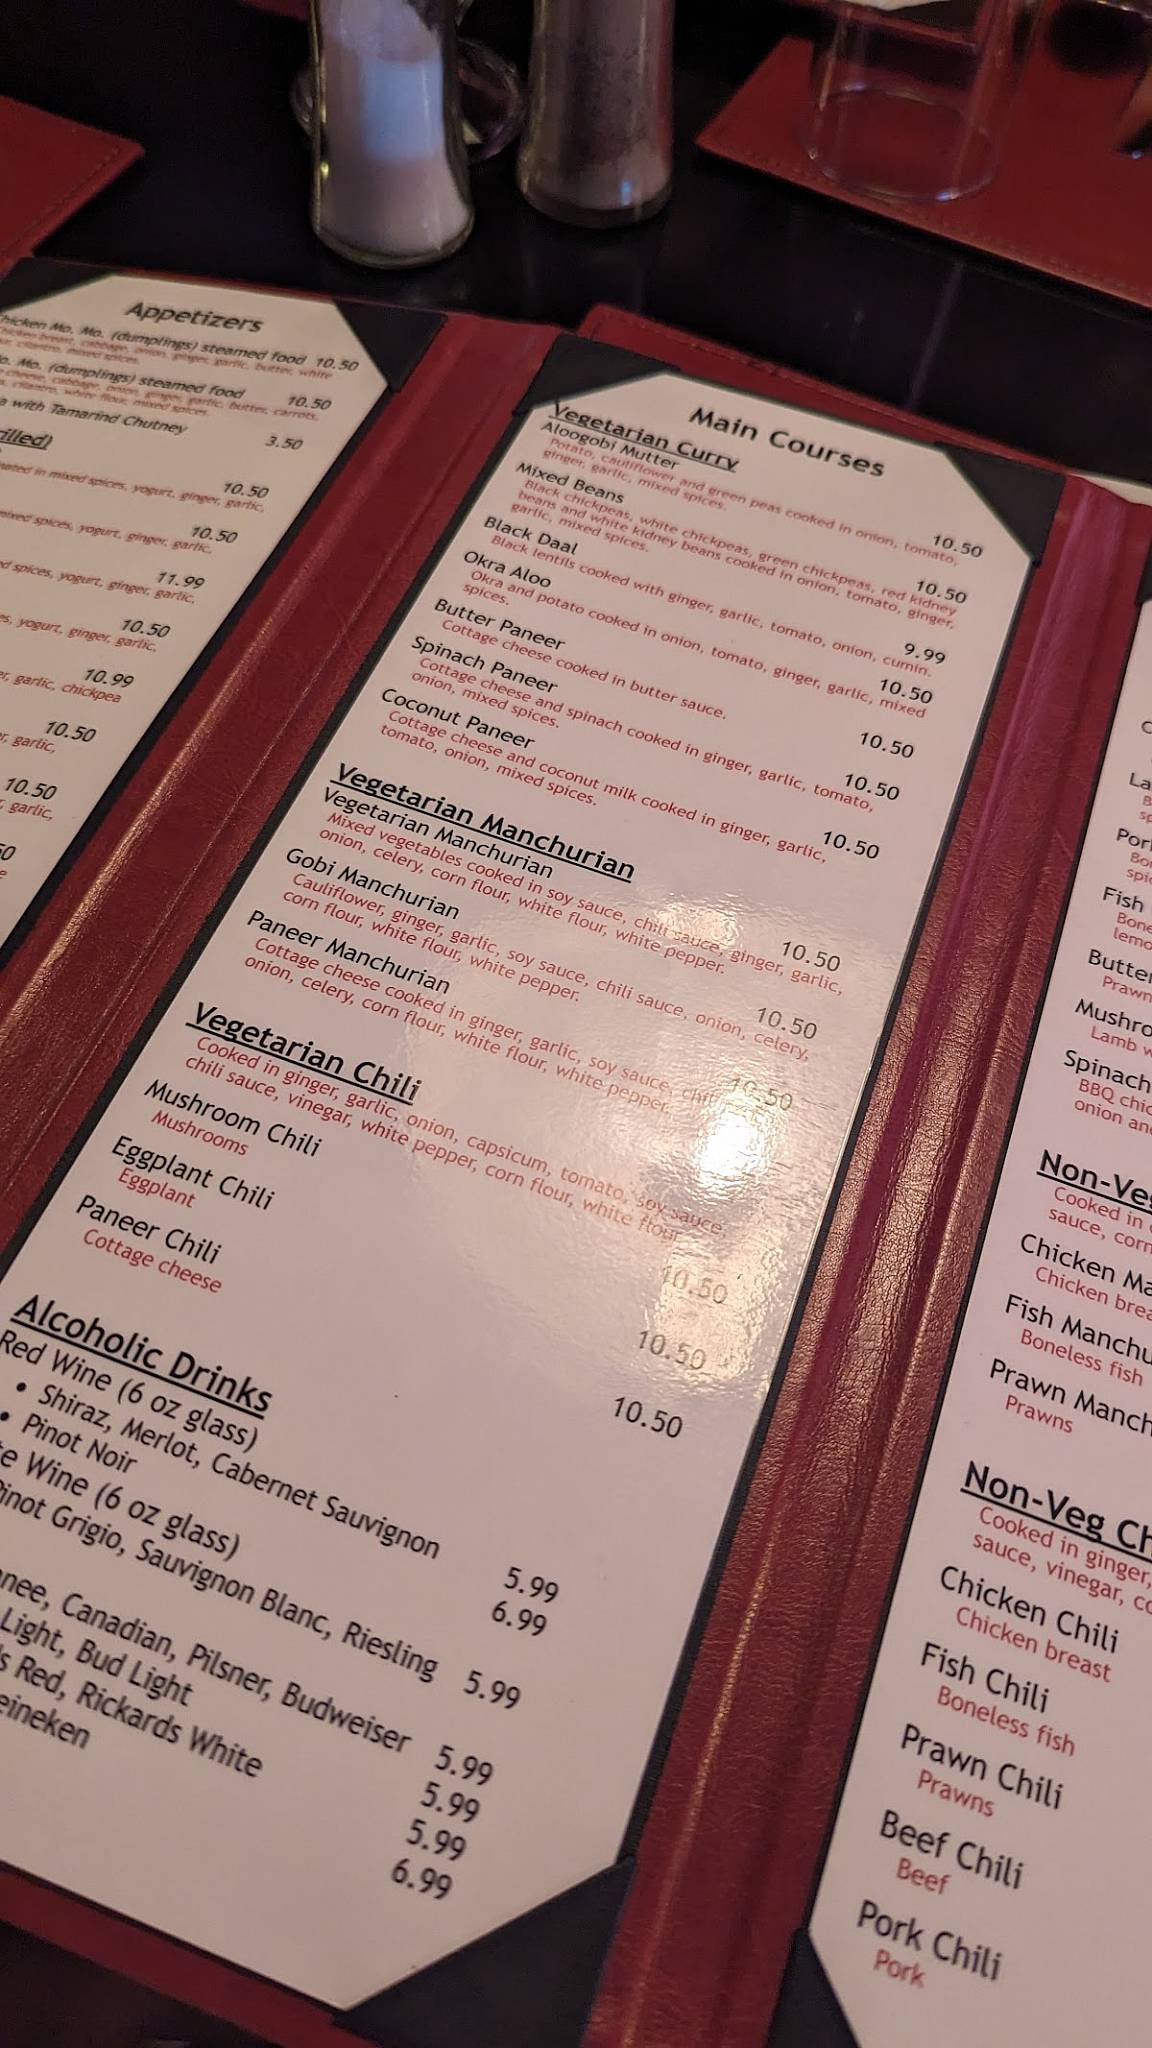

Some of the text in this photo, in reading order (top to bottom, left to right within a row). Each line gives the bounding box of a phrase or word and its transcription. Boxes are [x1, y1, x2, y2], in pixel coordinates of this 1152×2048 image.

[122, 300, 265, 334] Appetizers
[109, 330, 308, 366] (dumplings) steamed food
[315, 356, 360, 372] 10.50
[11, 399, 189, 437] with Tamarind Chutney
[264, 433, 305, 451] 3.50
[550, 402, 741, 470] Vegetarian Curry
[687, 405, 886, 478] Main Courses
[539, 420, 681, 471] Aloogobi Mutter
[223, 480, 270, 499] 10.50
[514, 460, 625, 505] Mixed Beans
[190, 524, 239, 544] 10.50
[483, 515, 579, 556] Black Daal
[933, 533, 985, 559] 10.50
[155, 570, 206, 590] 11.99
[463, 549, 552, 589] Okra Aloo
[916, 578, 969, 605] 10.50
[121, 618, 172, 639] 10.50
[433, 597, 567, 651] Butter Paneer
[490, 534, 932, 678] Black lentils cooked with ginger, garlic, tomato, onion, cumin.
[410, 635, 559, 694] Spinach Paneer
[441, 619, 726, 720] Cottage cheese cooked in butter sauce.
[903, 642, 947, 665] 9.99
[60, 683, 123, 704] chickpea
[82, 668, 135, 689] 10.99
[880, 677, 934, 705] 10.50
[381, 688, 537, 749] Coconut Paneer
[4, 777, 59, 801] 10.50
[323, 785, 554, 879] Vegetarian Manchurian
[337, 761, 635, 877] Vegetarian Manchurian
[285, 847, 460, 920] Gobi Manchurian
[1101, 885, 1146, 913] Fish
[246, 909, 451, 995] Paneer Manchurian
[282, 891, 580, 1002] corn flour, white flour, white pepper.
[782, 940, 841, 972] 10.50
[753, 1007, 818, 1040] 10.50
[1090, 1025, 1139, 1052] Lamb
[194, 1000, 423, 1102] Vegetarian Chili
[1063, 1049, 1152, 1096] Spinach
[1074, 1099, 1124, 1126] onion
[1077, 1077, 1116, 1105] BBQ
[143, 1078, 323, 1158] Mushroom Chili
[150, 1109, 249, 1156] Mushrooms
[111, 1134, 276, 1211] Eggplant Chili
[117, 1166, 197, 1209] Eggplant
[75, 1193, 223, 1265] Paneer Chili
[83, 1228, 223, 1294] Cottage cheese
[1020, 1233, 1116, 1284] Chicken
[1035, 1266, 1109, 1305] Chicken
[1004, 1293, 1054, 1330] Fish
[12, 1293, 274, 1414] Alcoholic Drinks
[0, 1328, 259, 1455] Red Wine (6 oz glass)
[989, 1357, 1067, 1406] Prawn
[1004, 1393, 1074, 1434] Prawns
[20, 1412, 139, 1474] Pinot Noir
[37, 1383, 441, 1560] Shiraz, Merlot, Cabernet Sauvignon
[963, 1459, 1107, 1539] Non-Veg
[979, 1505, 1080, 1560] Cooked in
[50, 1504, 441, 1684] Grigio, Sauvignon Blanc, Riesling
[502, 1565, 560, 1604] 5.99
[972, 1533, 1125, 1607] sauce, vinegar,
[490, 1600, 548, 1637] 6.99
[940, 1565, 1120, 1655] Chicken Chili
[0, 1606, 195, 1708] Light, Bud Light
[955, 1605, 1113, 1684] Chicken breast
[60, 1592, 414, 1754] Canadian, Pilsner, Budweiser
[462, 1669, 522, 1710] 5.99
[919, 1640, 1051, 1714] Fish Chili
[12, 1654, 264, 1779] Red, Rickards White
[936, 1684, 1076, 1758] Boneless fish
[899, 1722, 1065, 1811] Prawn Chili
[916, 1768, 995, 1818] Prawns
[405, 1817, 468, 1862] 5.99
[878, 1808, 1025, 1891] Beef Chili
[390, 1857, 454, 1901] 6.99
[895, 1856, 953, 1896] Beef
[856, 1898, 1004, 1982] Pork Chili
[872, 1948, 926, 1989] Pork
